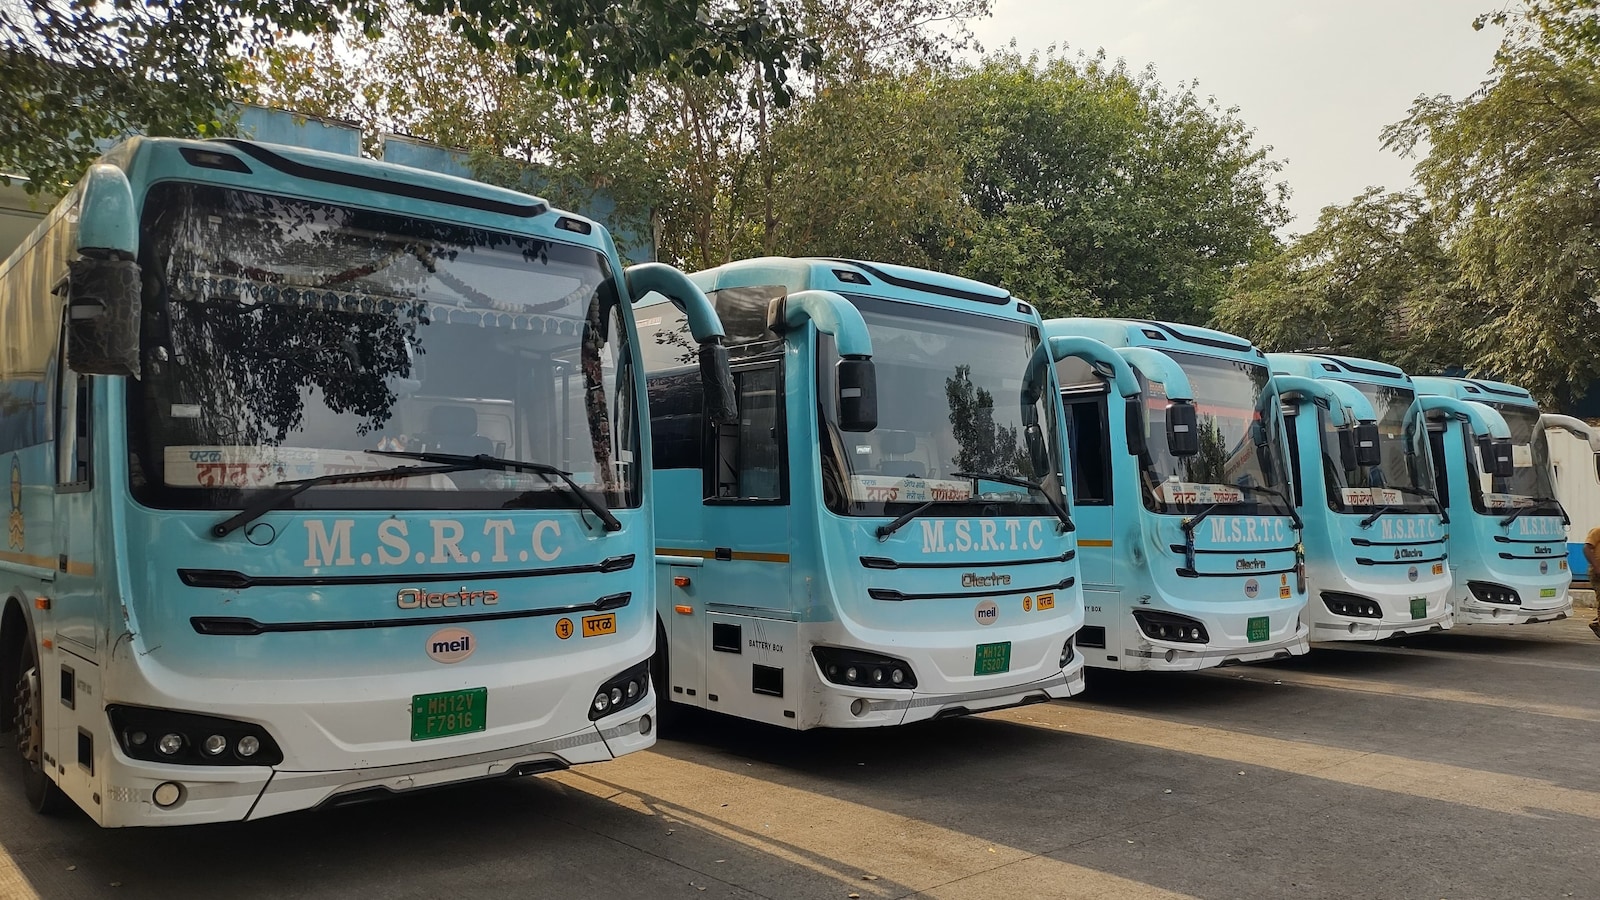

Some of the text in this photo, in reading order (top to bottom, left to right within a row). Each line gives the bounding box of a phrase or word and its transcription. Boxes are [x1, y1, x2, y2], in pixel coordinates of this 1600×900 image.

[920, 519, 1043, 553] M.S.R.T.C
[1210, 517, 1284, 543] M.S.R.T.C
[1381, 518, 1435, 540] M.S.R.T.C
[303, 519, 562, 567] M.S.R.T.C
[397, 586, 499, 610] Olectra
[978, 607, 996, 618] meil
[586, 617, 612, 632] परळ
[432, 637, 470, 654] meil
[748, 639, 784, 653] BATTERY BOX
[982, 658, 1005, 672] F5207
[428, 694, 474, 714] MH12V
[426, 712, 473, 734] F7816
